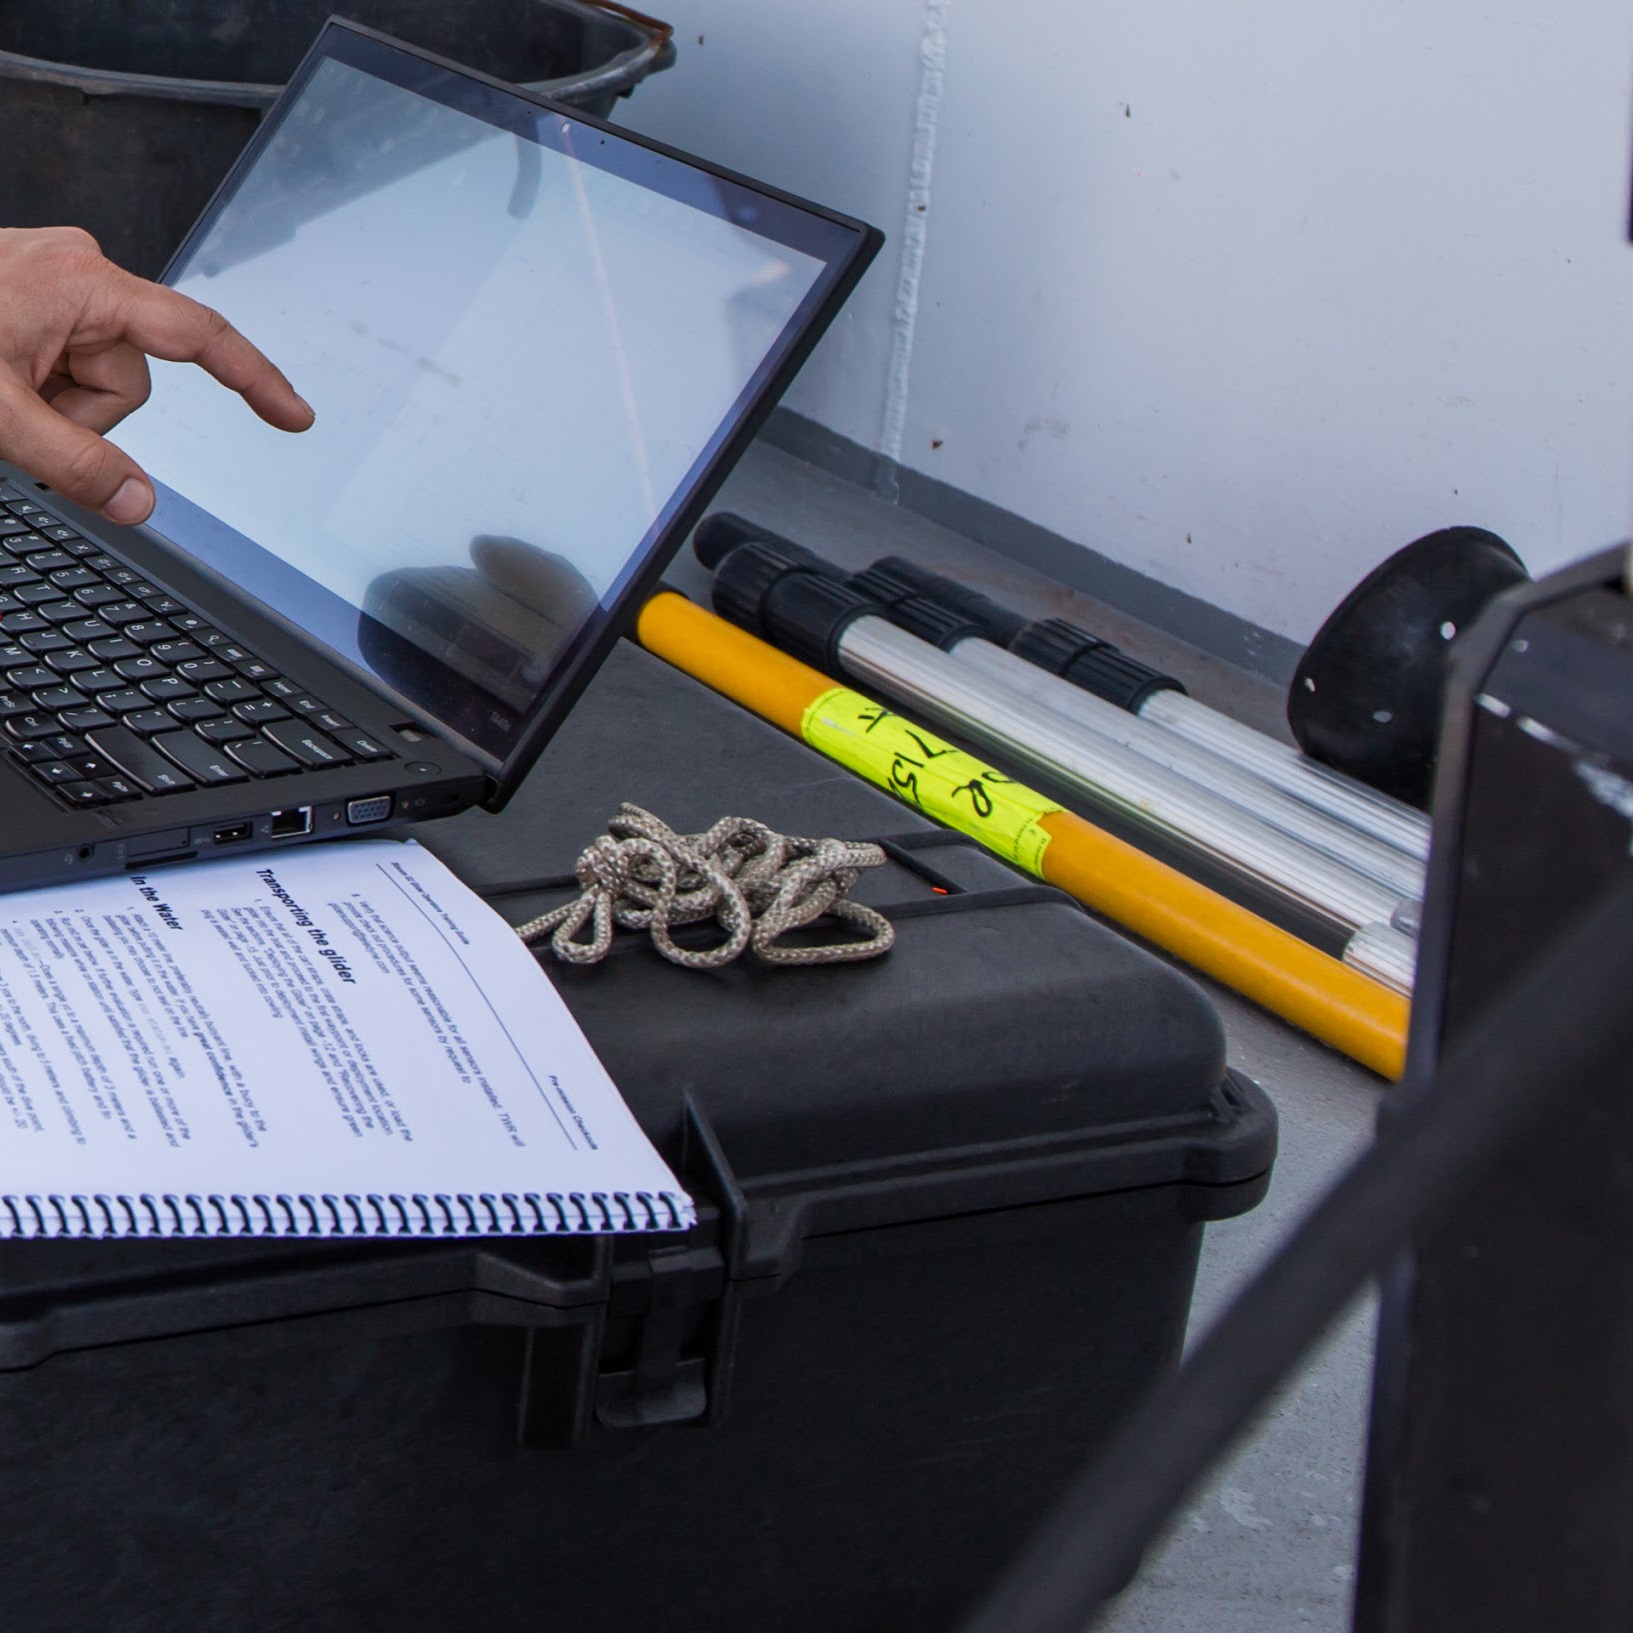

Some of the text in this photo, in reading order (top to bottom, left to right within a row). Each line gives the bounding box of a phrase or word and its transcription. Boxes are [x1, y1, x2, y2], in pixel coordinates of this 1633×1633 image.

[4, 647, 21, 655] M
[274, 682, 292, 693] Home
[299, 700, 315, 708] End
[302, 740, 333, 759] Backspace
[210, 765, 228, 776] Enter
[130, 875, 183, 930] In the Water
[234, 931, 248, 943] page
[255, 868, 356, 984] Transporting the glider
[441, 913, 458, 930] Training
[455, 931, 469, 945] Guide
[214, 924, 232, 939] seated
[234, 952, 248, 962] and
[243, 963, 261, 982] tucked
[256, 983, 268, 994] into
[252, 956, 267, 967] Just
[259, 968, 275, 980] prior
[342, 902, 363, 918] provide
[359, 919, 375, 933] check
[377, 944, 407, 976] procedures
[409, 988, 425, 1005] some
[421, 1007, 442, 1033] sensors
[445, 1046, 467, 1073] request
[243, 907, 260, 919] glider
[270, 938, 285, 949] boat
[279, 950, 293, 960] and
[286, 962, 309, 984] proceed
[317, 1005, 330, 1016] first
[325, 1018, 348, 1048] waypoint
[347, 1060, 377, 1102] deployment
[275, 990, 304, 1025] deployment
[259, 906, 278, 922] Ensure
[299, 955, 312, 965] cart
[321, 988, 336, 1003] crate
[345, 1028, 360, 1041] and
[354, 1043, 370, 1062] locks
[365, 1064, 377, 1076] are
[391, 1111, 406, 1126] load
[400, 1129, 413, 1141] the
[359, 901, 374, 913] Verify
[379, 924, 399, 943] science
[395, 945, 414, 962] output
[409, 964, 427, 984] seems
[424, 986, 451, 1023] reasonable
[460, 1046, 482, 1075] sensors
[499, 1113, 517, 1132] TWR
[511, 1135, 525, 1146] will
[299, 1027, 316, 1046] install
[311, 1048, 327, 1068] wings
[309, 1021, 326, 1037] page
[328, 1053, 343, 1067] and
[362, 1116, 374, 1128] the
[322, 1071, 336, 1084] and
[331, 1087, 350, 1112] ensure
[549, 1075, 598, 1150] Pre-mission Checkouts
[342, 1115, 362, 1136] green
